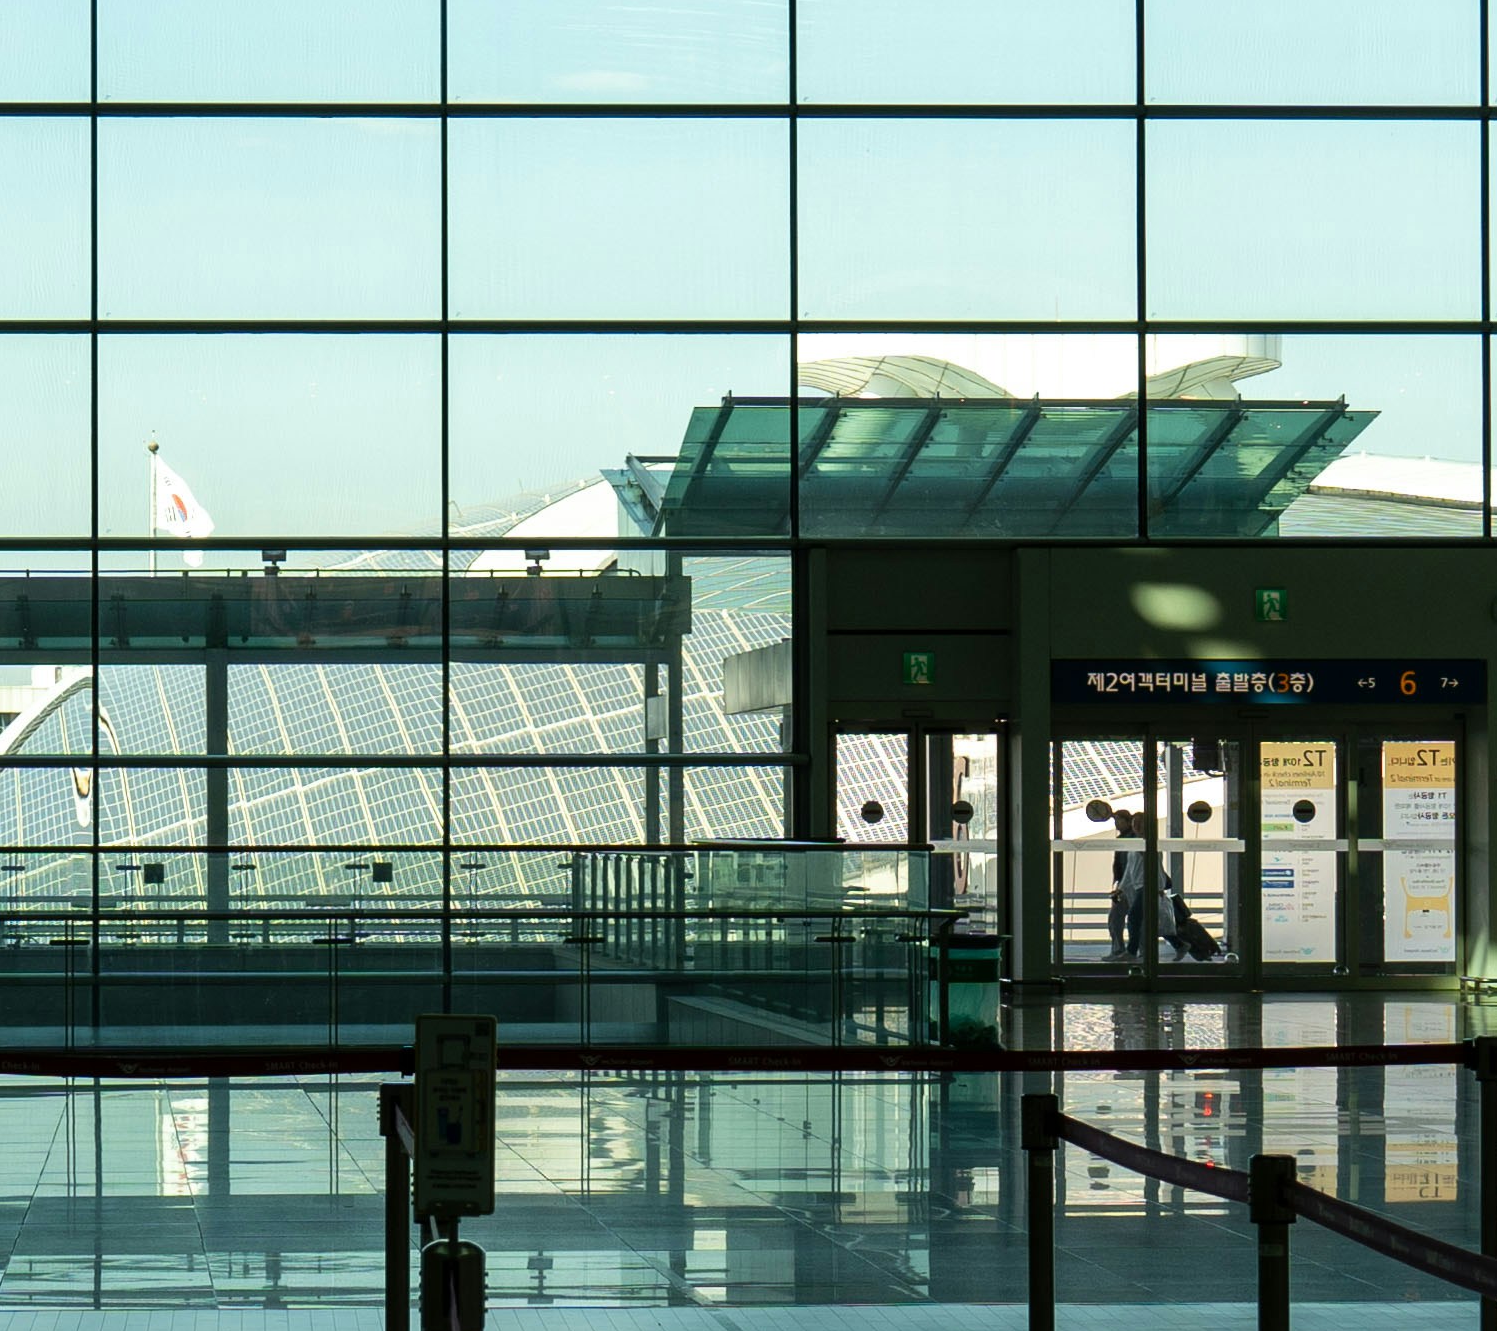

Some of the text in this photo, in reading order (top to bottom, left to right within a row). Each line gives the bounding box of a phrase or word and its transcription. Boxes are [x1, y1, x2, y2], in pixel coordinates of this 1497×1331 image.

[1086, 671, 1315, 694] 제2여객터미널 출발층(3층)
[1399, 670, 1417, 696] 6
